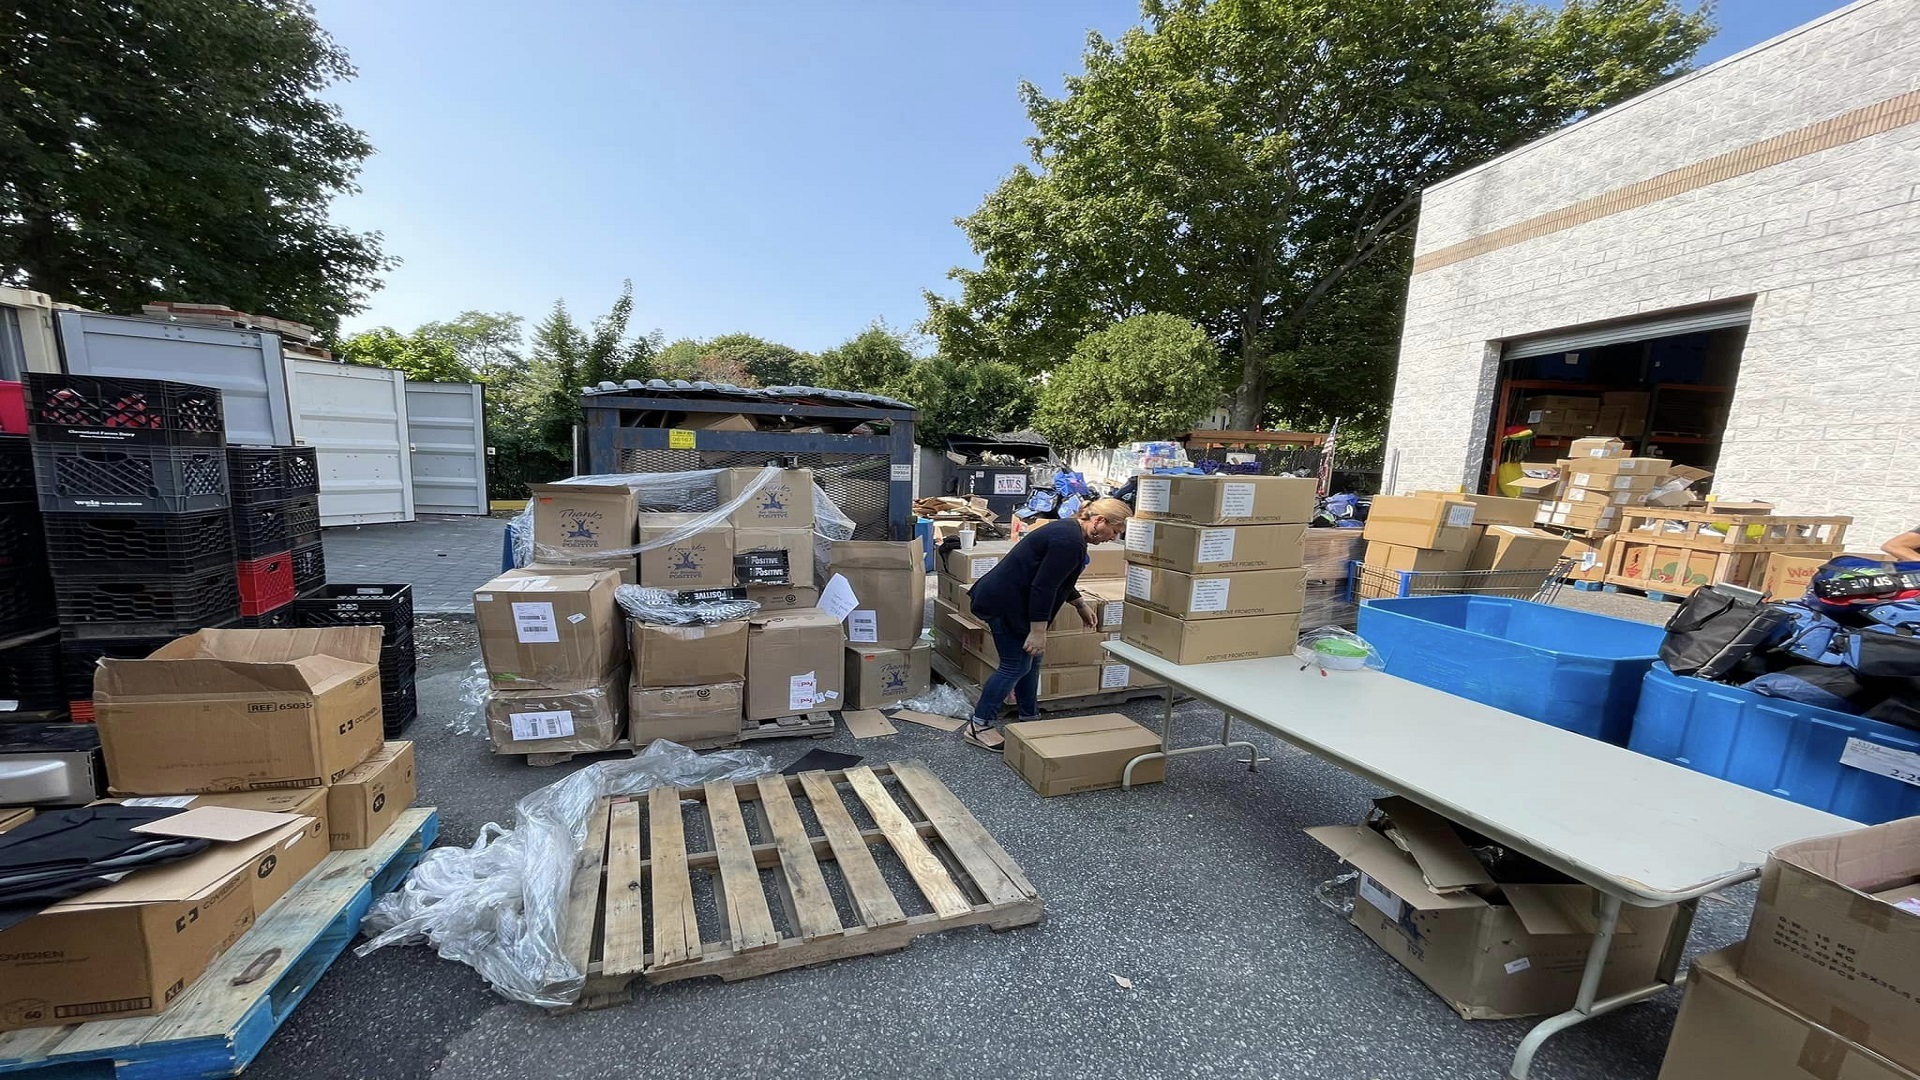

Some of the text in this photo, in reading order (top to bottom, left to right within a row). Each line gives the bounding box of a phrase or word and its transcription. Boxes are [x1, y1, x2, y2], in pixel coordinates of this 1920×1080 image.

[559, 509, 603, 519] Thanks
[694, 590, 727, 600] POSITIVE
[279, 702, 313, 710] 65035
[0, 951, 64, 961] OVIDIEN
[24, 1011, 42, 1020] 60
